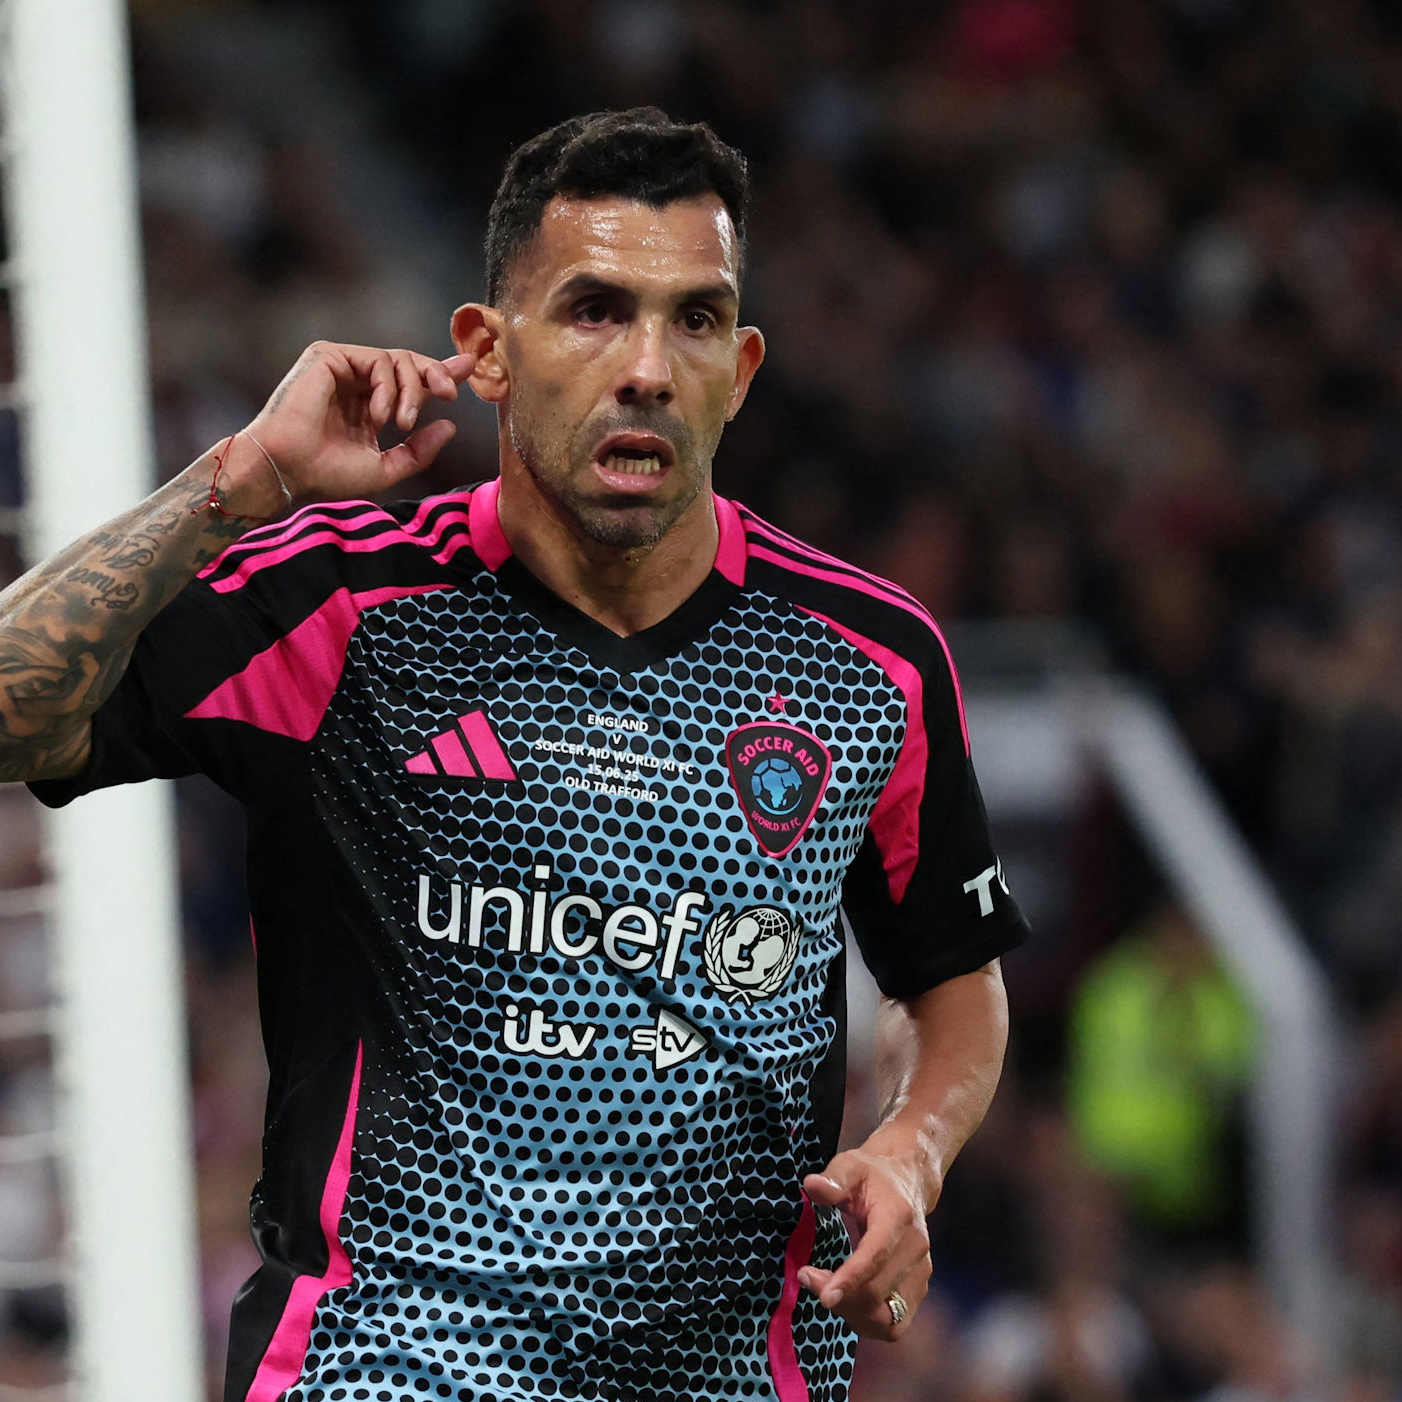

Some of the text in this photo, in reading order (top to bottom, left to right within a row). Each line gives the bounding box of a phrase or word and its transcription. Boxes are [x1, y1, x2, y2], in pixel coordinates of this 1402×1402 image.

[587, 714, 649, 732] ENGLAND
[612, 733, 623, 745] V
[535, 739, 695, 775] SOCCER AID WORLD XI FC
[736, 736, 820, 776] SOCCER AID
[587, 763, 639, 782] 15.06.25
[565, 776, 659, 802] OLD TRAFFORD
[751, 810, 802, 832] WORLD XI FC
[417, 865, 706, 979] unicef
[503, 1004, 696, 1057] itv stv
